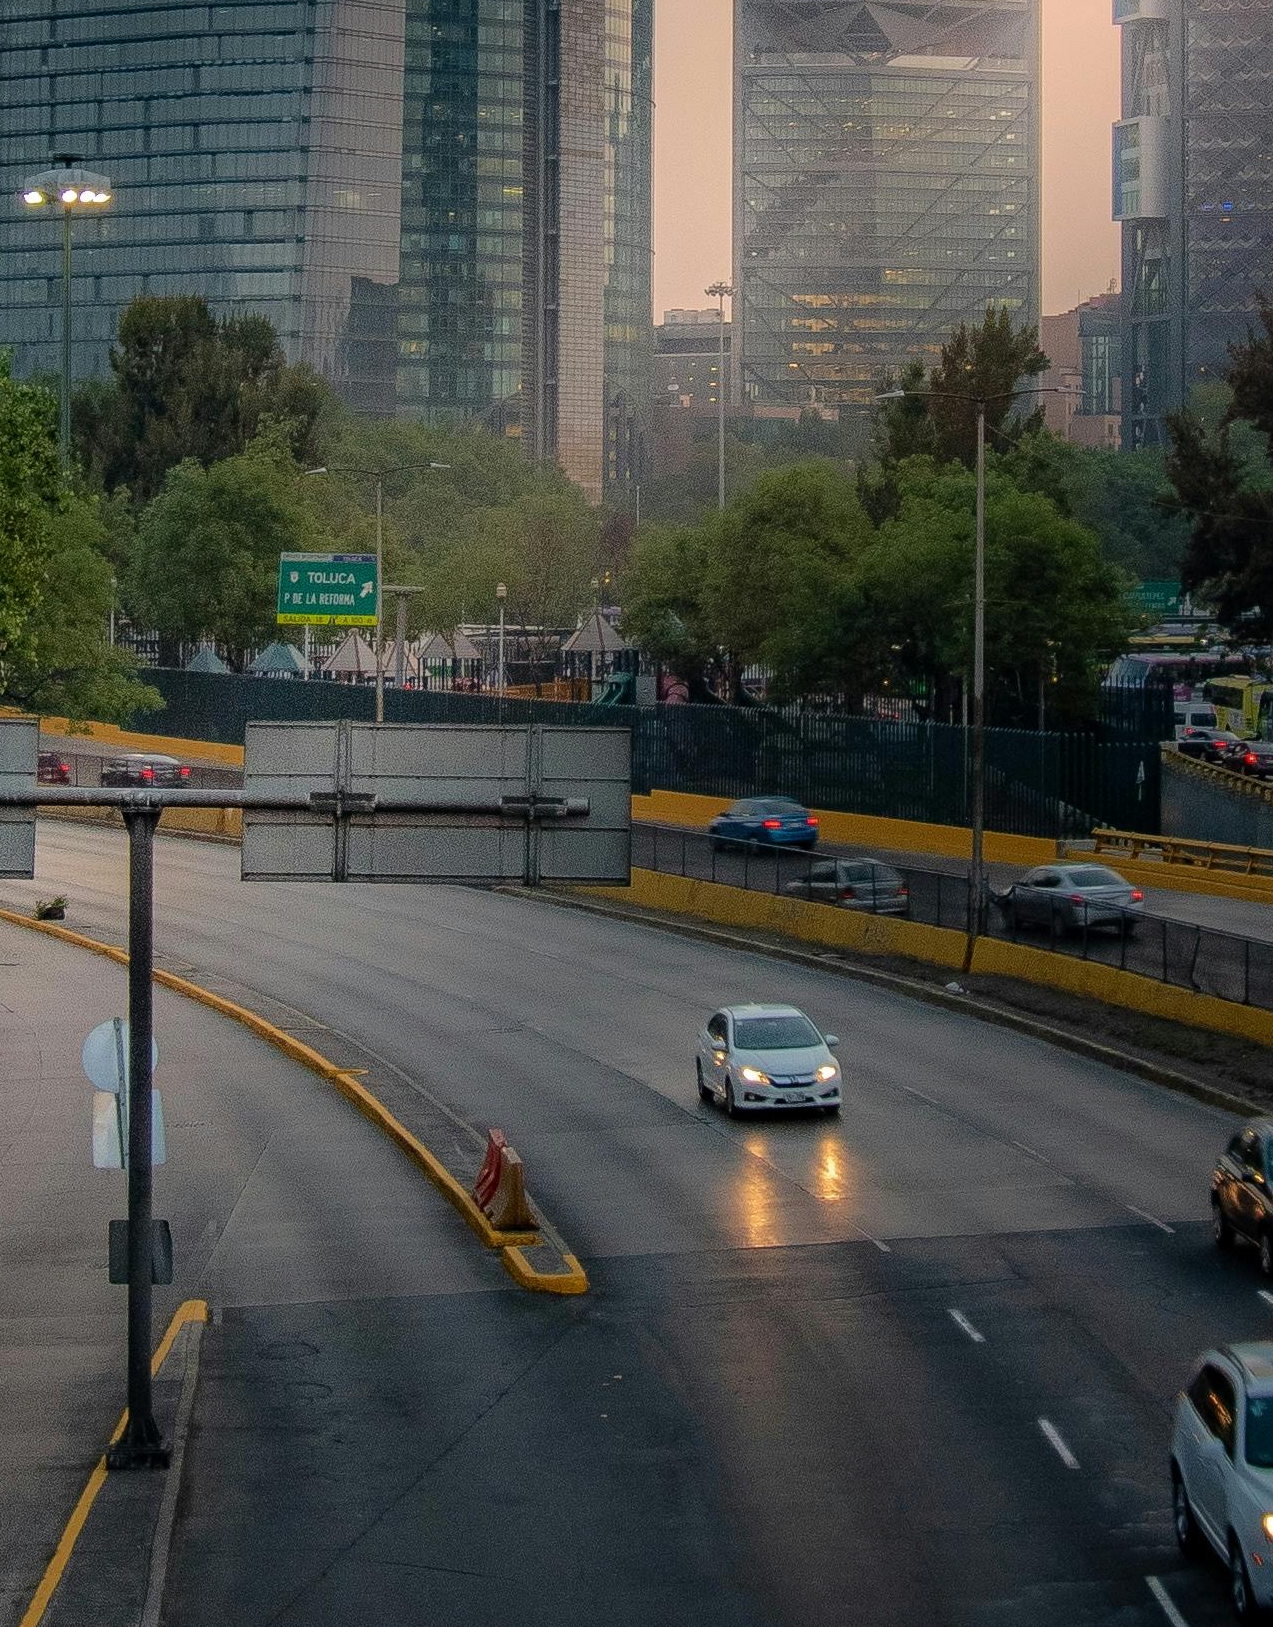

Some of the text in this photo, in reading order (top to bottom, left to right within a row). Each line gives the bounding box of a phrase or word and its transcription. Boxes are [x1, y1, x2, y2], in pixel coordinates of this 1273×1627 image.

[308, 572, 355, 584] TOLUCA
[285, 593, 355, 606] P DE LA REFORMA
